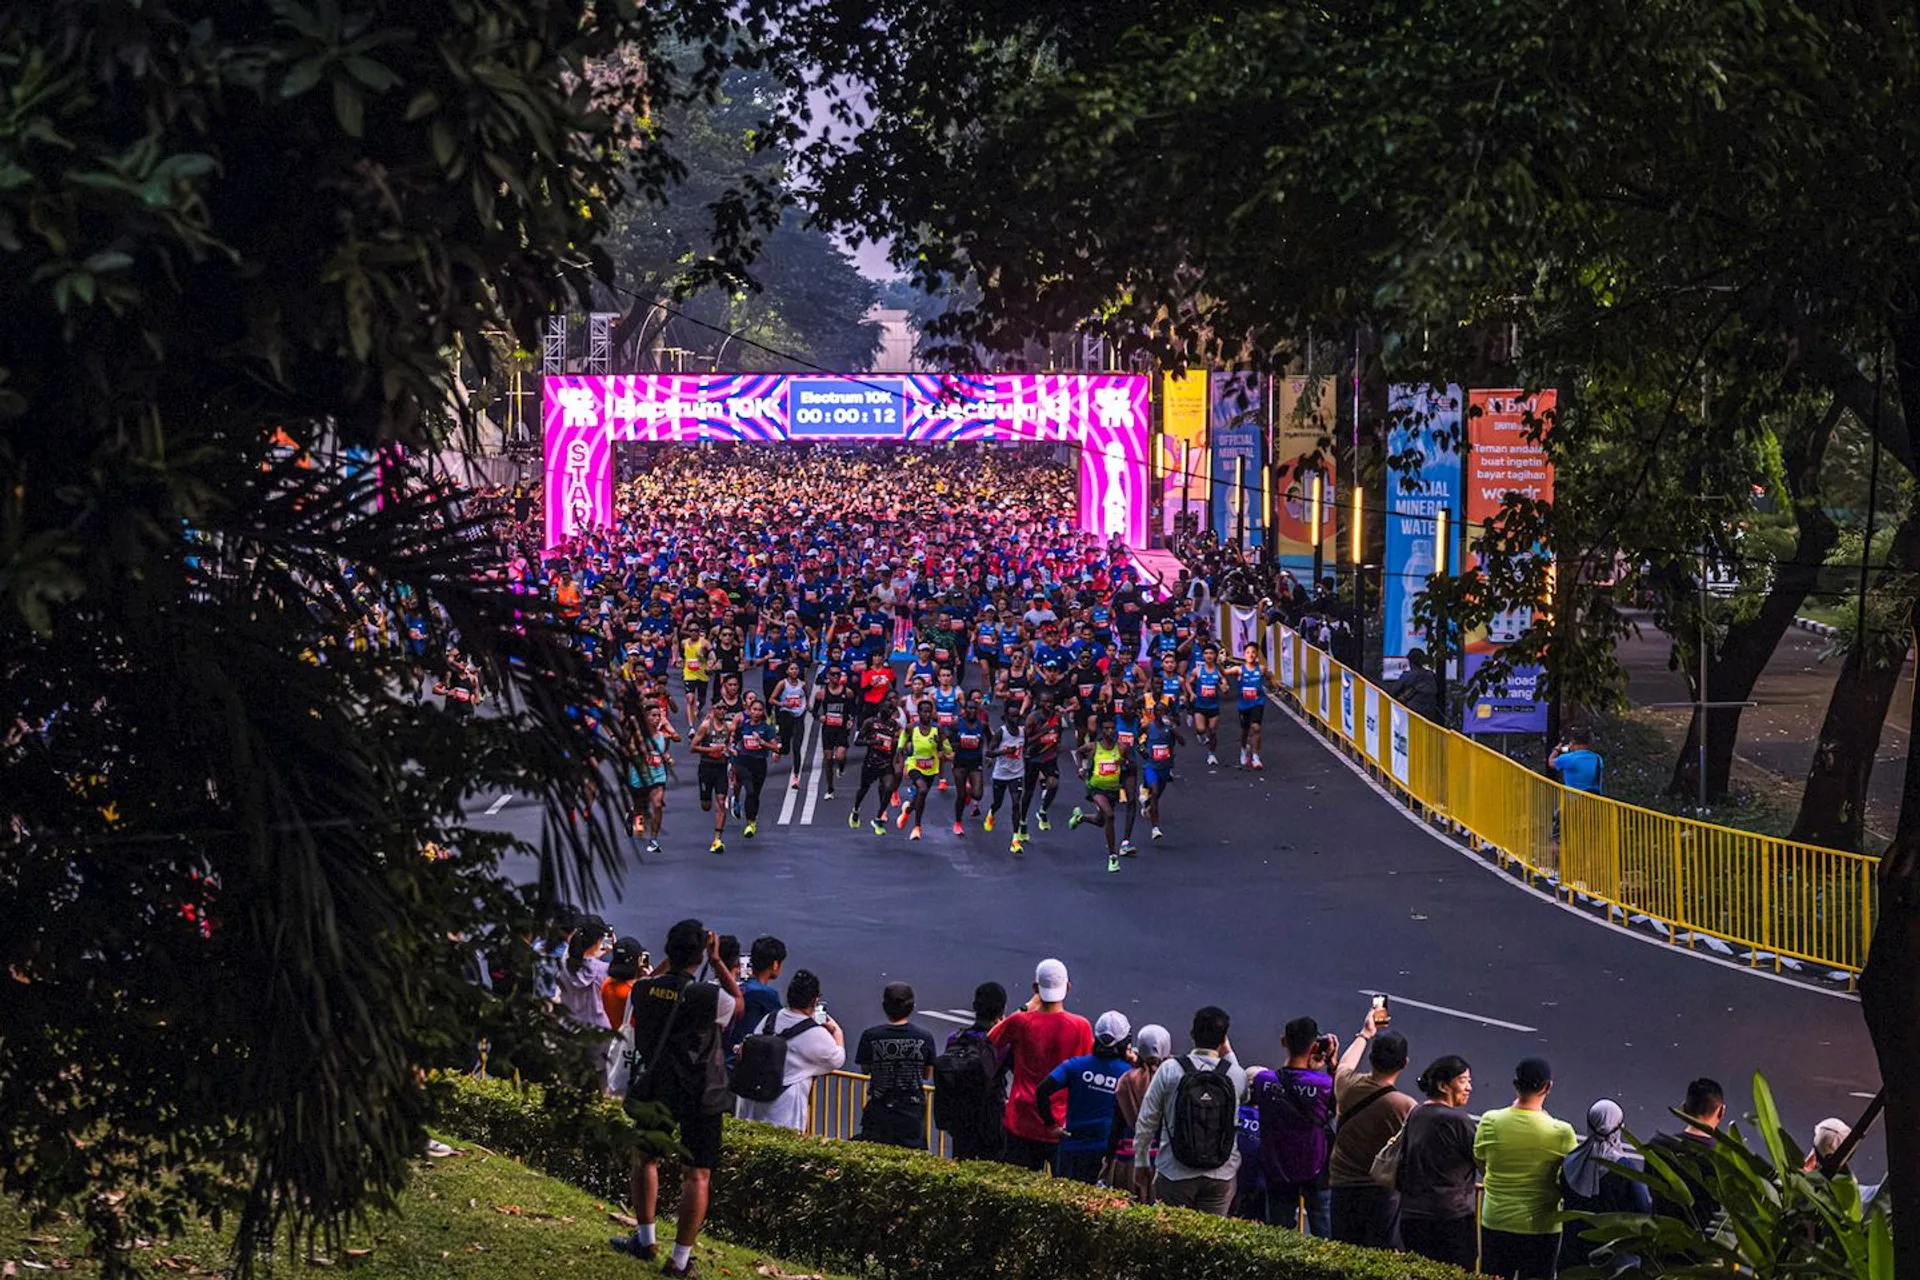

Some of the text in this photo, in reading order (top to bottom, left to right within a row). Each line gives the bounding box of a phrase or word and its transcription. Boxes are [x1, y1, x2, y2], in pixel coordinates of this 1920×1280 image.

[864, 391, 894, 403] 10K
[1473, 443, 1507, 453] Teman
[1481, 456, 1542, 468] buat ingetin
[1476, 469, 1546, 482] bayar tagihan
[1401, 518, 1437, 535] WATE
[649, 986, 682, 1002] MEDI
